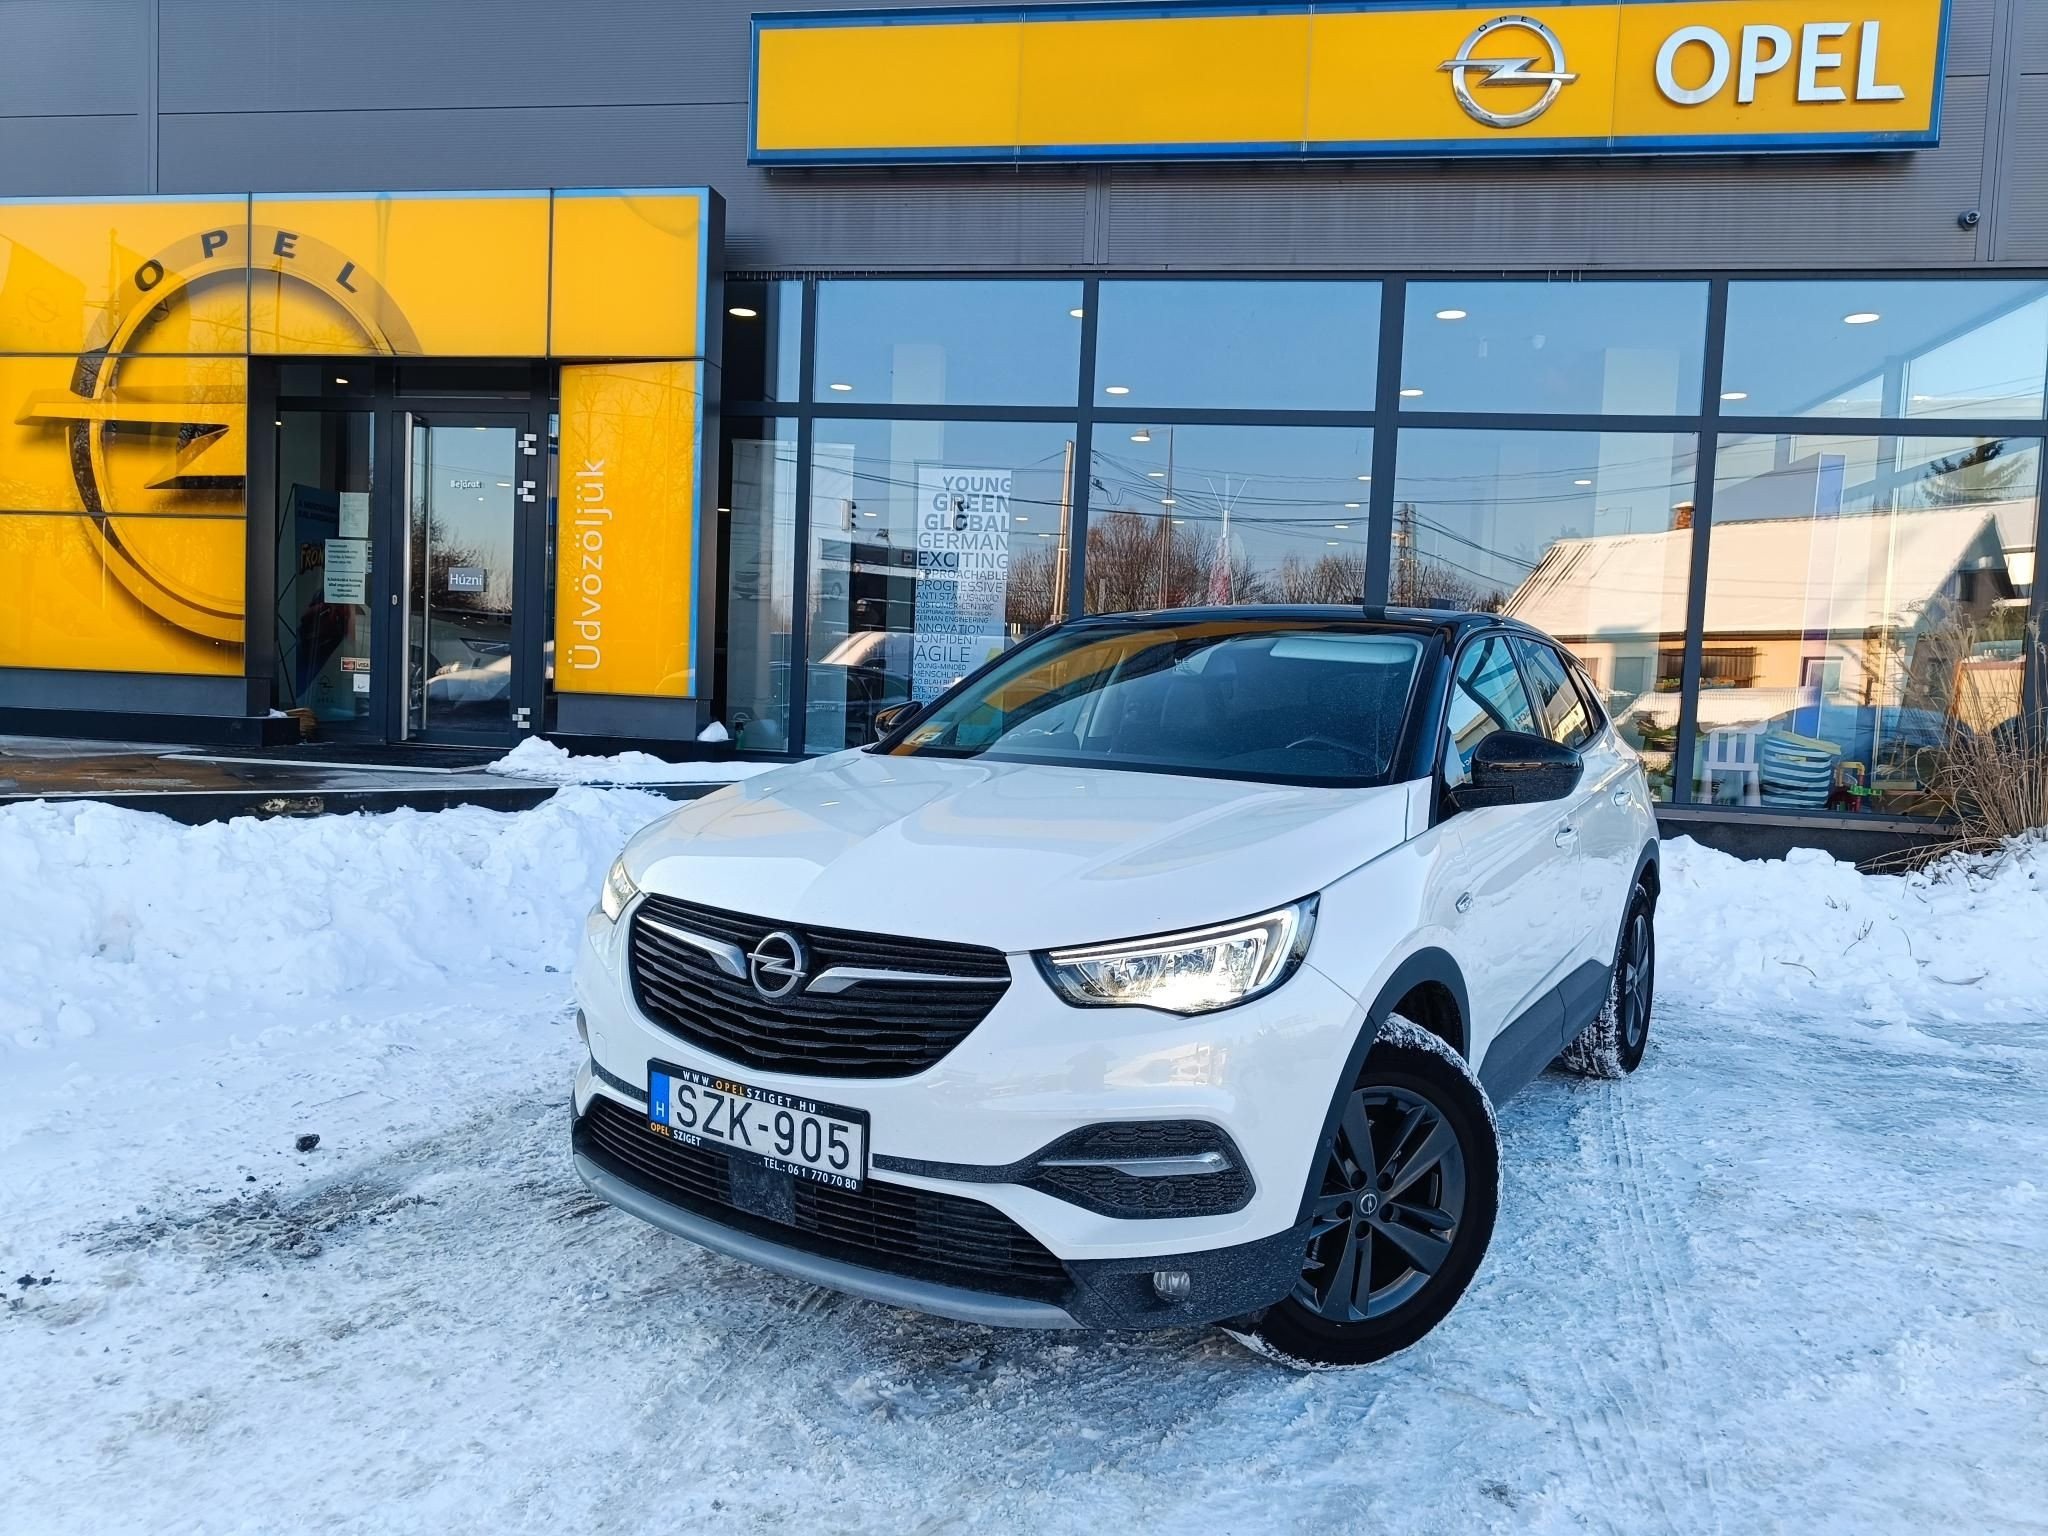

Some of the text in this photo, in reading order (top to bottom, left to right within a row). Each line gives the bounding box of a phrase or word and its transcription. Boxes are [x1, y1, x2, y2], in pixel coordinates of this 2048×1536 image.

[1478, 16, 1545, 32] OPEL
[1655, 20, 1906, 105] OPEL
[134, 229, 358, 292] OPEL
[943, 476, 1011, 492] YOUNG
[933, 493, 1009, 512] GREEN
[924, 513, 1009, 532] GLOBAL
[918, 532, 1008, 550] GERMAN
[568, 459, 612, 669] Üdvözöljük
[918, 551, 1008, 569] EXCITING
[450, 573, 482, 586] Húzni
[917, 569, 1007, 581] APPROACHABLE
[916, 580, 1002, 593] PROGRESSIVE
[916, 592, 937, 600] ANTI
[916, 623, 985, 634] INNOVATION
[915, 634, 979, 645] CONFIDENT
[914, 645, 971, 662] AGILE
[914, 662, 967, 671] YOUNG-MINDED
[683, 1070, 816, 1114] WWW.OPELSZIGET.HU
[655, 1101, 665, 1118] H
[650, 1124, 702, 1147] OPEL SZIGET
[676, 1084, 850, 1170] SZK-905
[788, 1164, 799, 1176] 06
[811, 1170, 828, 1183] 770
[831, 1175, 842, 1187] 70
[845, 1178, 857, 1190] 80
